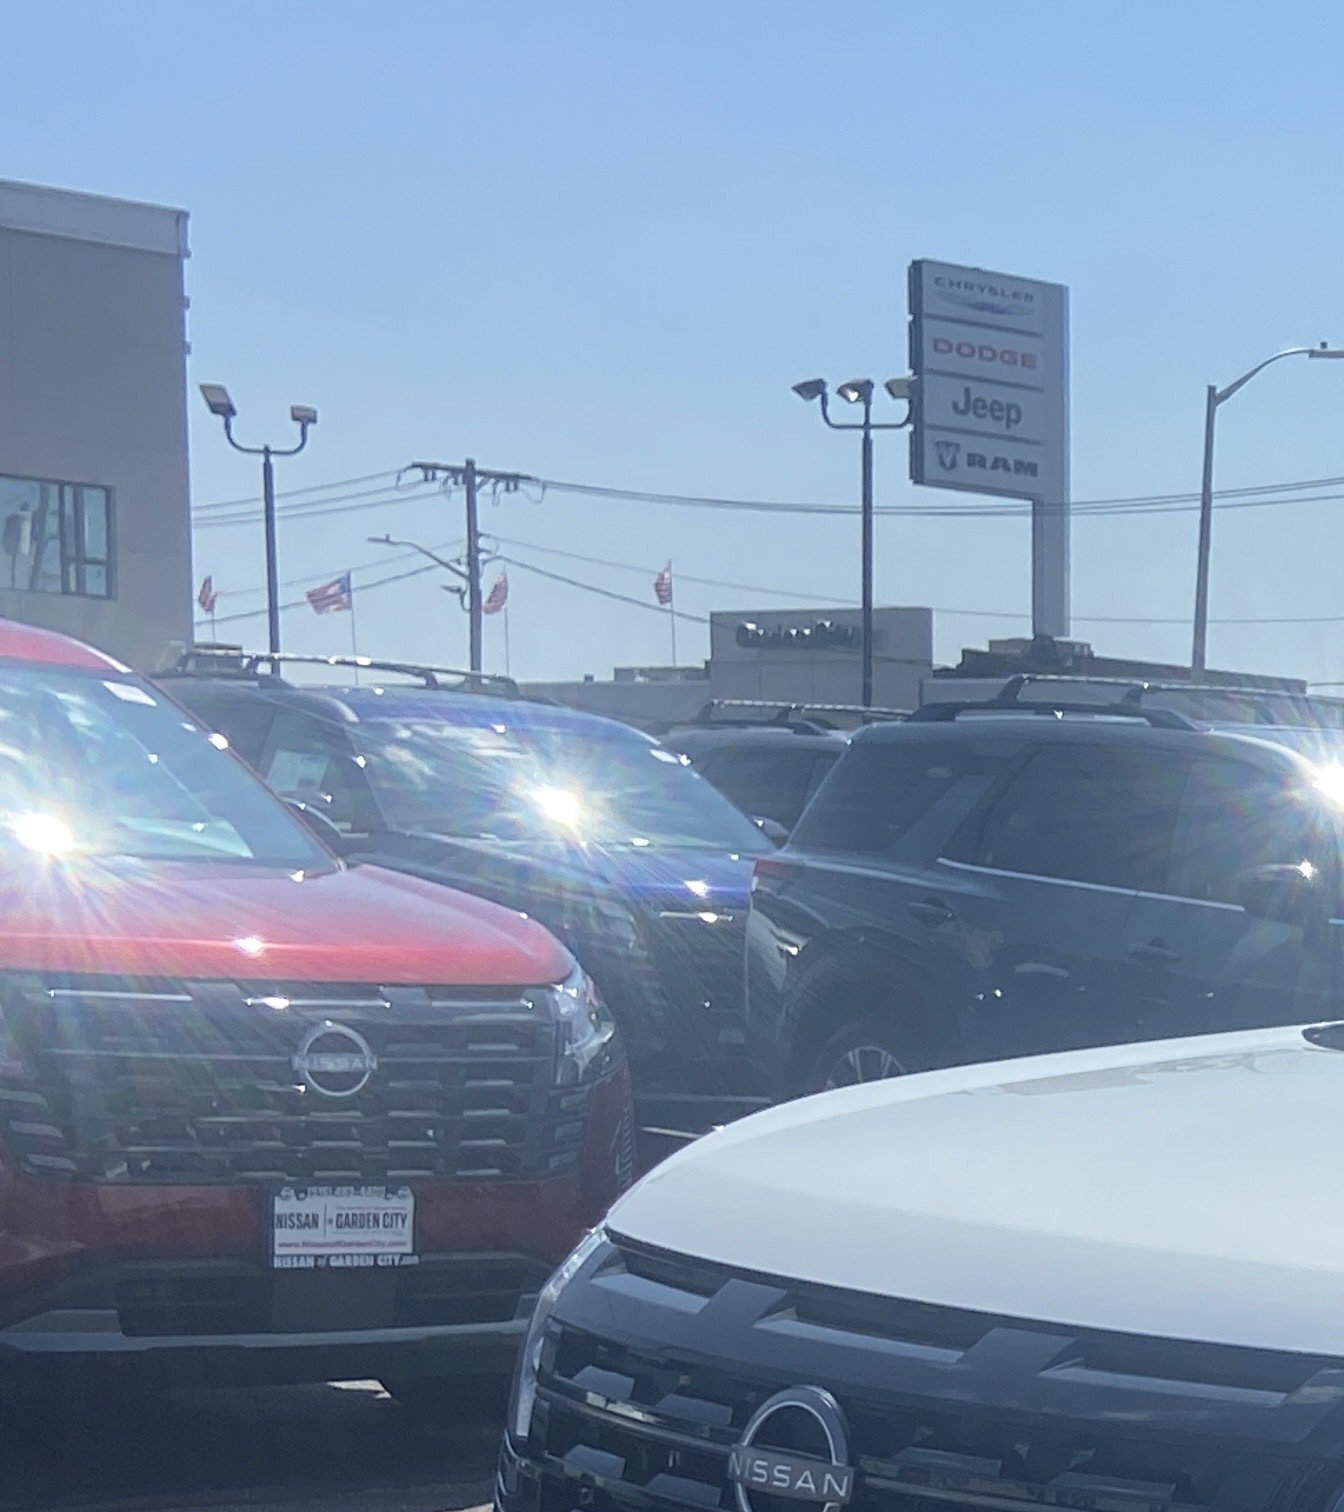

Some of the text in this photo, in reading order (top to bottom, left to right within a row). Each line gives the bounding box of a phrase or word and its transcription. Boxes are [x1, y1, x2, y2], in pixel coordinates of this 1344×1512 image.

[934, 277, 1034, 302] CHRYSLER
[932, 338, 1038, 369] DODGE
[952, 387, 1023, 430] Jeep
[966, 452, 1039, 478] RAM
[275, 1213, 319, 1230] NISSAN
[335, 1212, 380, 1230] GARDEN
[382, 1212, 408, 1229] CITY
[728, 1451, 848, 1497] NISSAN
